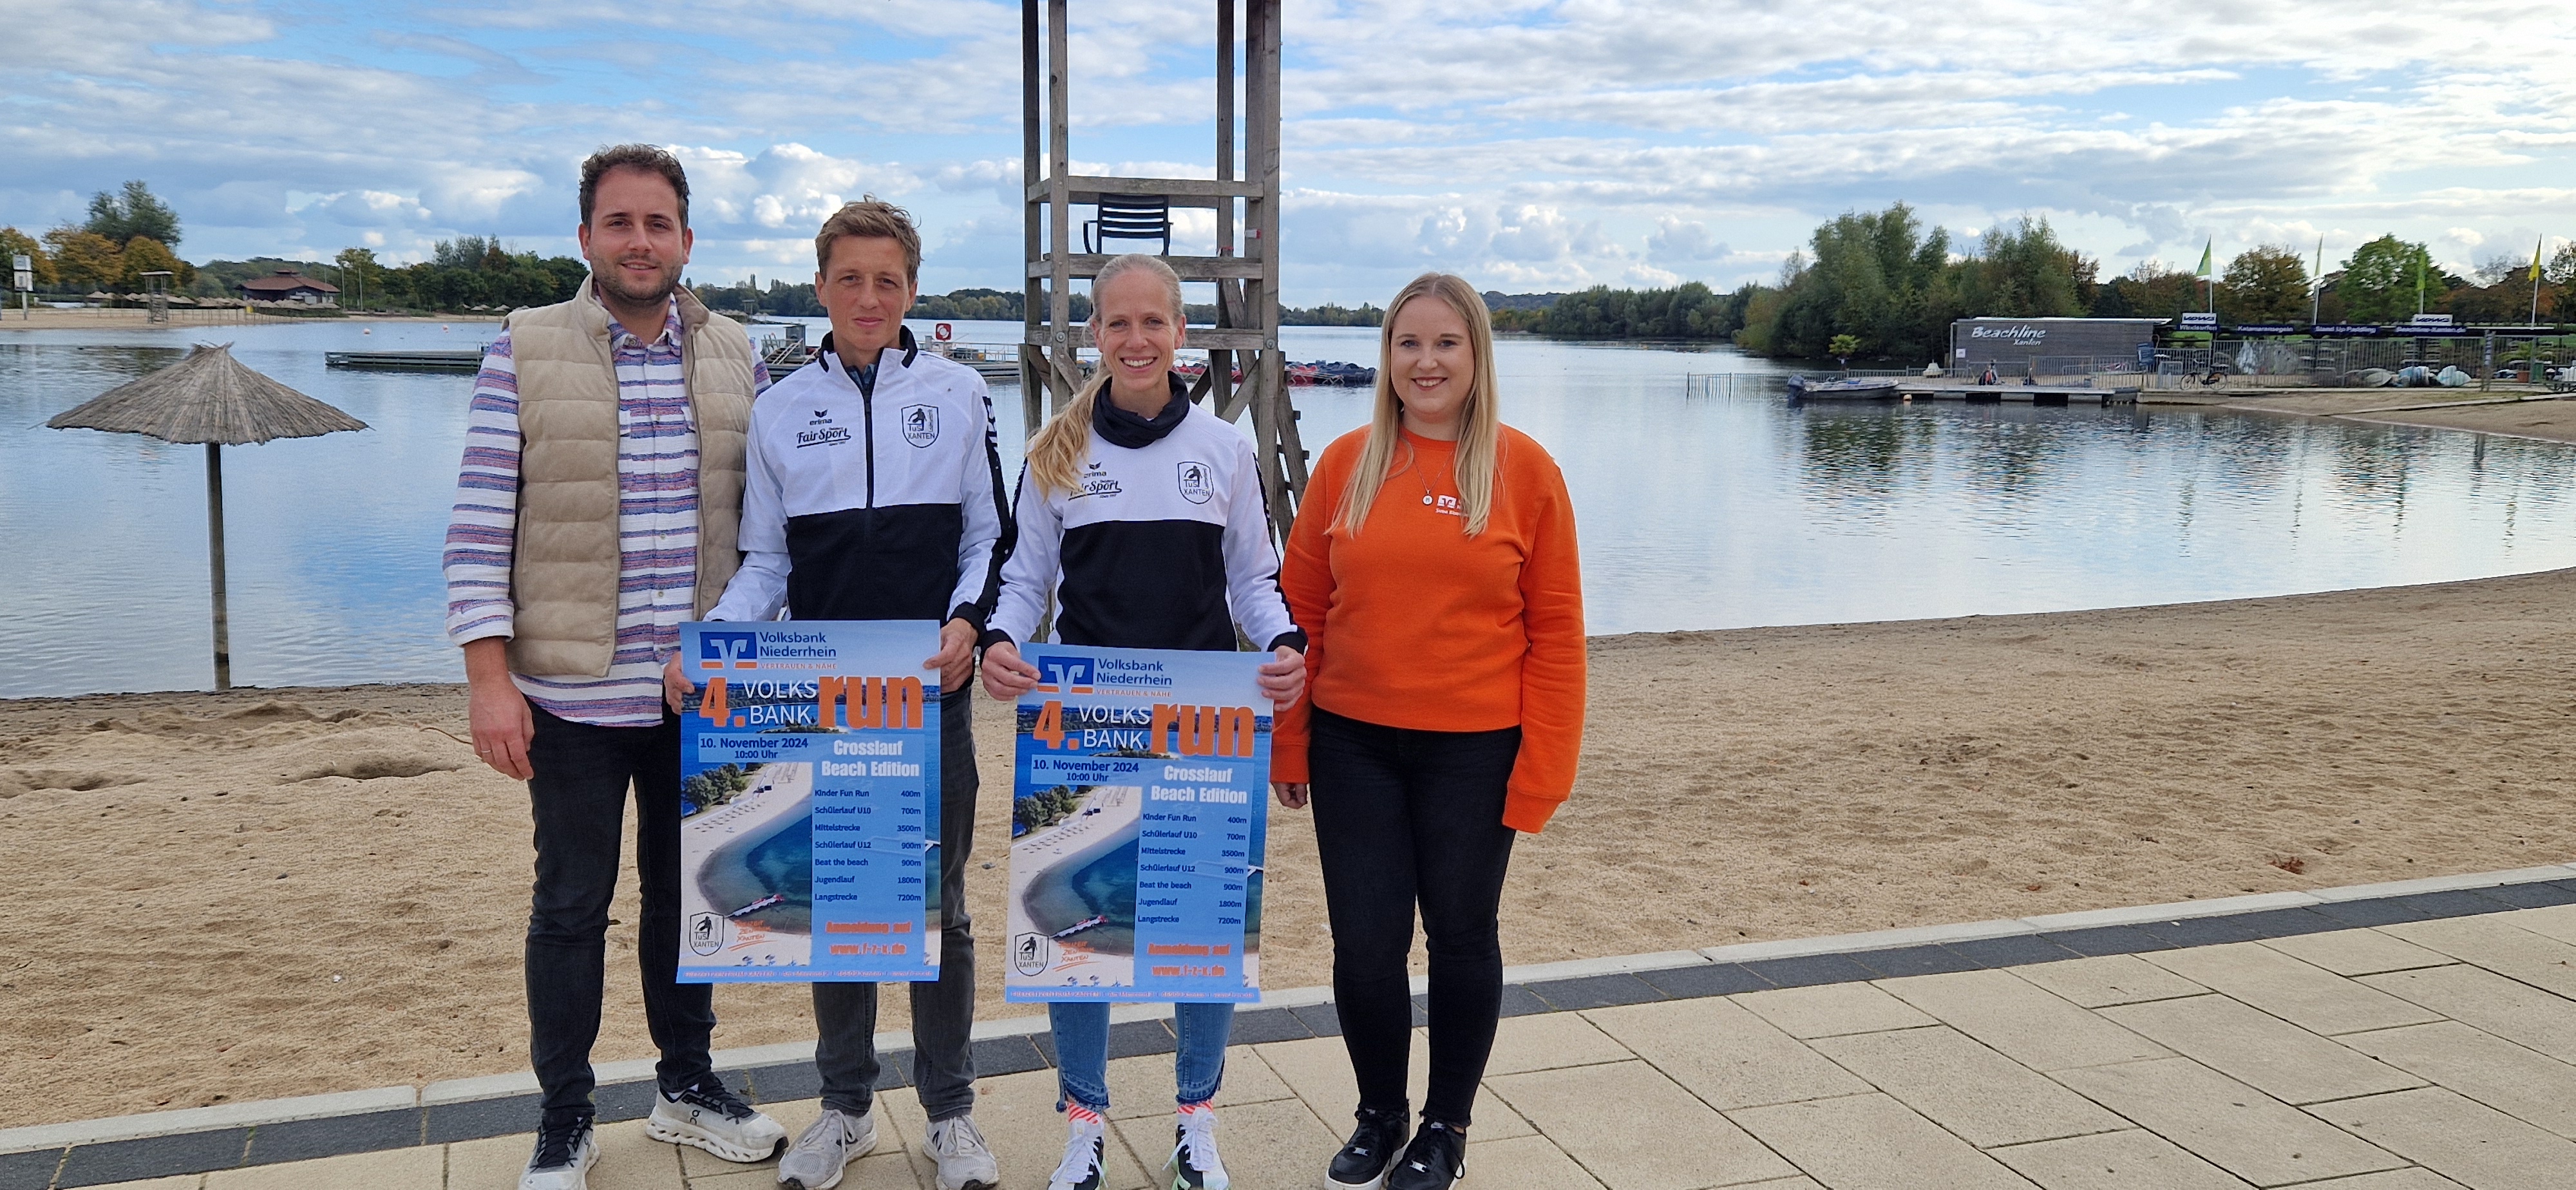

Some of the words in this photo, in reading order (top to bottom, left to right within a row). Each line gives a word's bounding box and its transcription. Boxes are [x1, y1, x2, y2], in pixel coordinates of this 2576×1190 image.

[1971, 324, 2047, 338] Beachline
[1184, 488, 1210, 497] XANTEN
[759, 631, 826, 643] Volksbank
[760, 645, 837, 657] Niederrhein
[1098, 658, 1164, 672] Volksbank
[1097, 672, 1172, 686] Niederrhein
[743, 679, 817, 699] VOLKS
[699, 676, 746, 727] 4.
[818, 675, 923, 729] run
[750, 705, 811, 724] BANK
[1079, 704, 1150, 725] VOLKS
[1033, 700, 1079, 750] 4.
[1150, 703, 1255, 757] run
[700, 738, 716, 748] 10.
[720, 737, 779, 749] November
[781, 737, 808, 748] 2024
[1083, 729, 1144, 749] BANK
[735, 750, 759, 759] 10:00
[761, 750, 778, 759] Uhr
[833, 740, 904, 756] Crosslauf
[821, 761, 867, 777] Beach
[871, 762, 920, 777] Edition
[1032, 759, 1049, 770] 10.
[1053, 760, 1110, 772] November
[1113, 762, 1139, 773] 2024
[1066, 773, 1090, 781] 10:00
[1092, 773, 1109, 782] Uhr
[1164, 765, 1233, 783] Crosslauf
[1151, 786, 1195, 802] Beach
[1199, 788, 1247, 804] Edition
[1141, 847, 1186, 855] Mittelstrecke
[815, 876, 855, 885] Jugendlauf
[815, 893, 858, 902] Langstrecke
[1139, 898, 1178, 907] Jugendlauf
[1138, 915, 1179, 924] Langstrecke
